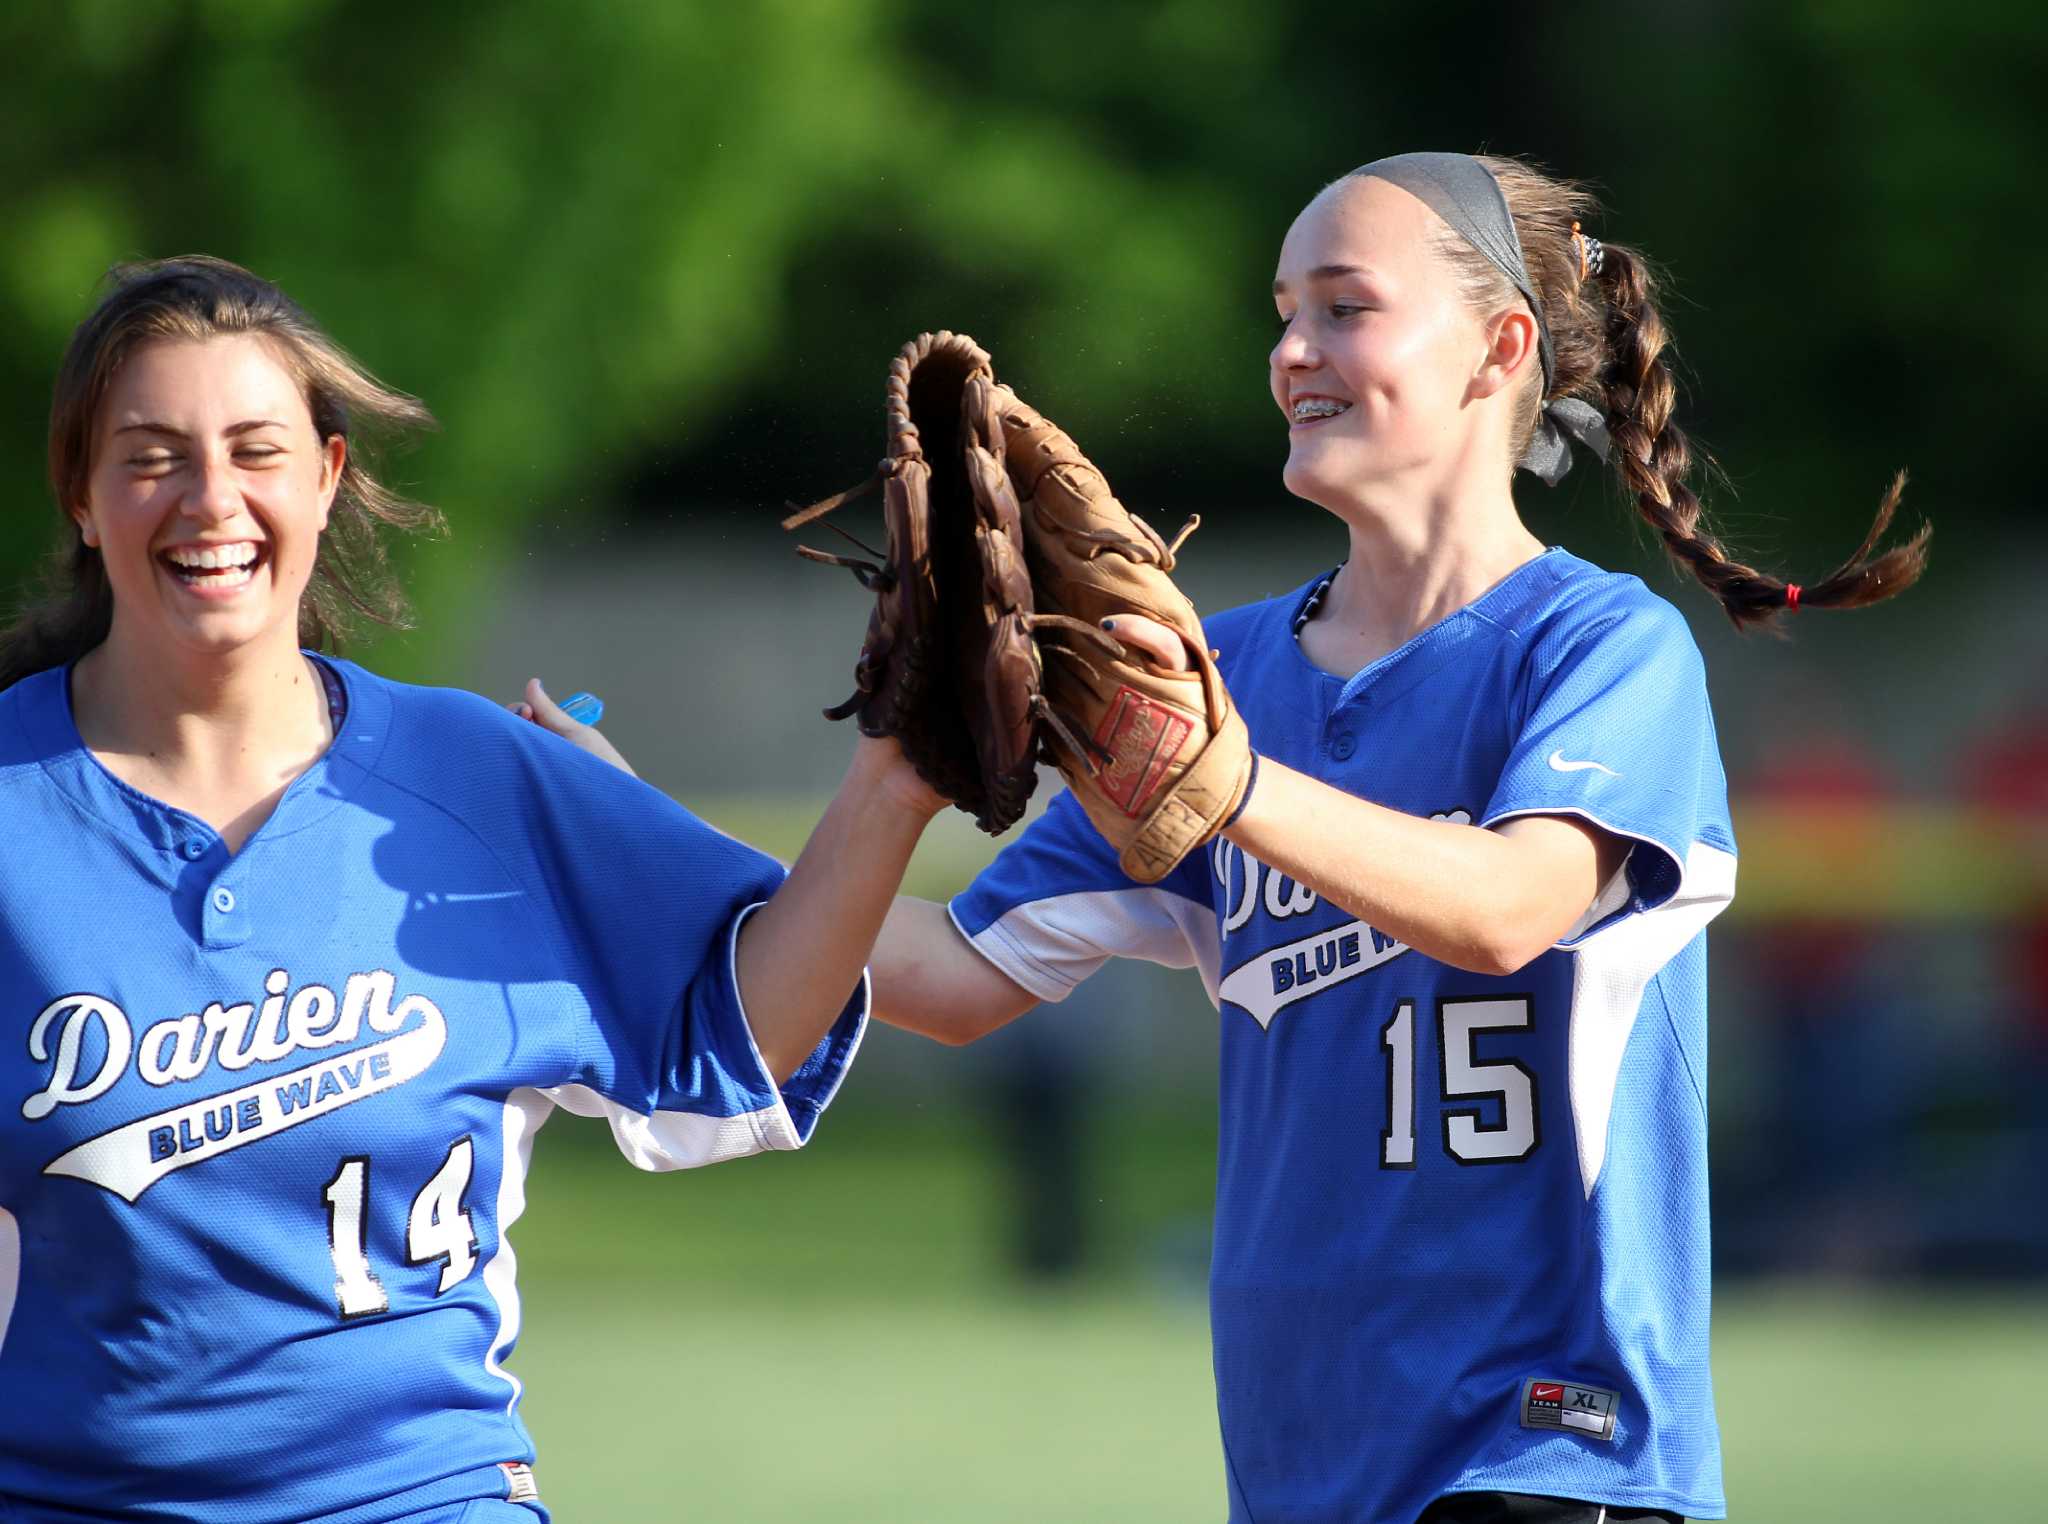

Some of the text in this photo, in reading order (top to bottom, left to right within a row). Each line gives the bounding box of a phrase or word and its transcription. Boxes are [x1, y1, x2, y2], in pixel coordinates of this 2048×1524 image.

[1271, 931, 1361, 995] BLUE
[22, 968, 412, 1119] Darien
[1382, 997, 1539, 1170] 15
[149, 1052, 392, 1164] BLUE WAVE
[322, 1134, 480, 1320] 14
[1532, 1400, 1558, 1408] TEAM
[1573, 1392, 1598, 1410] XL
